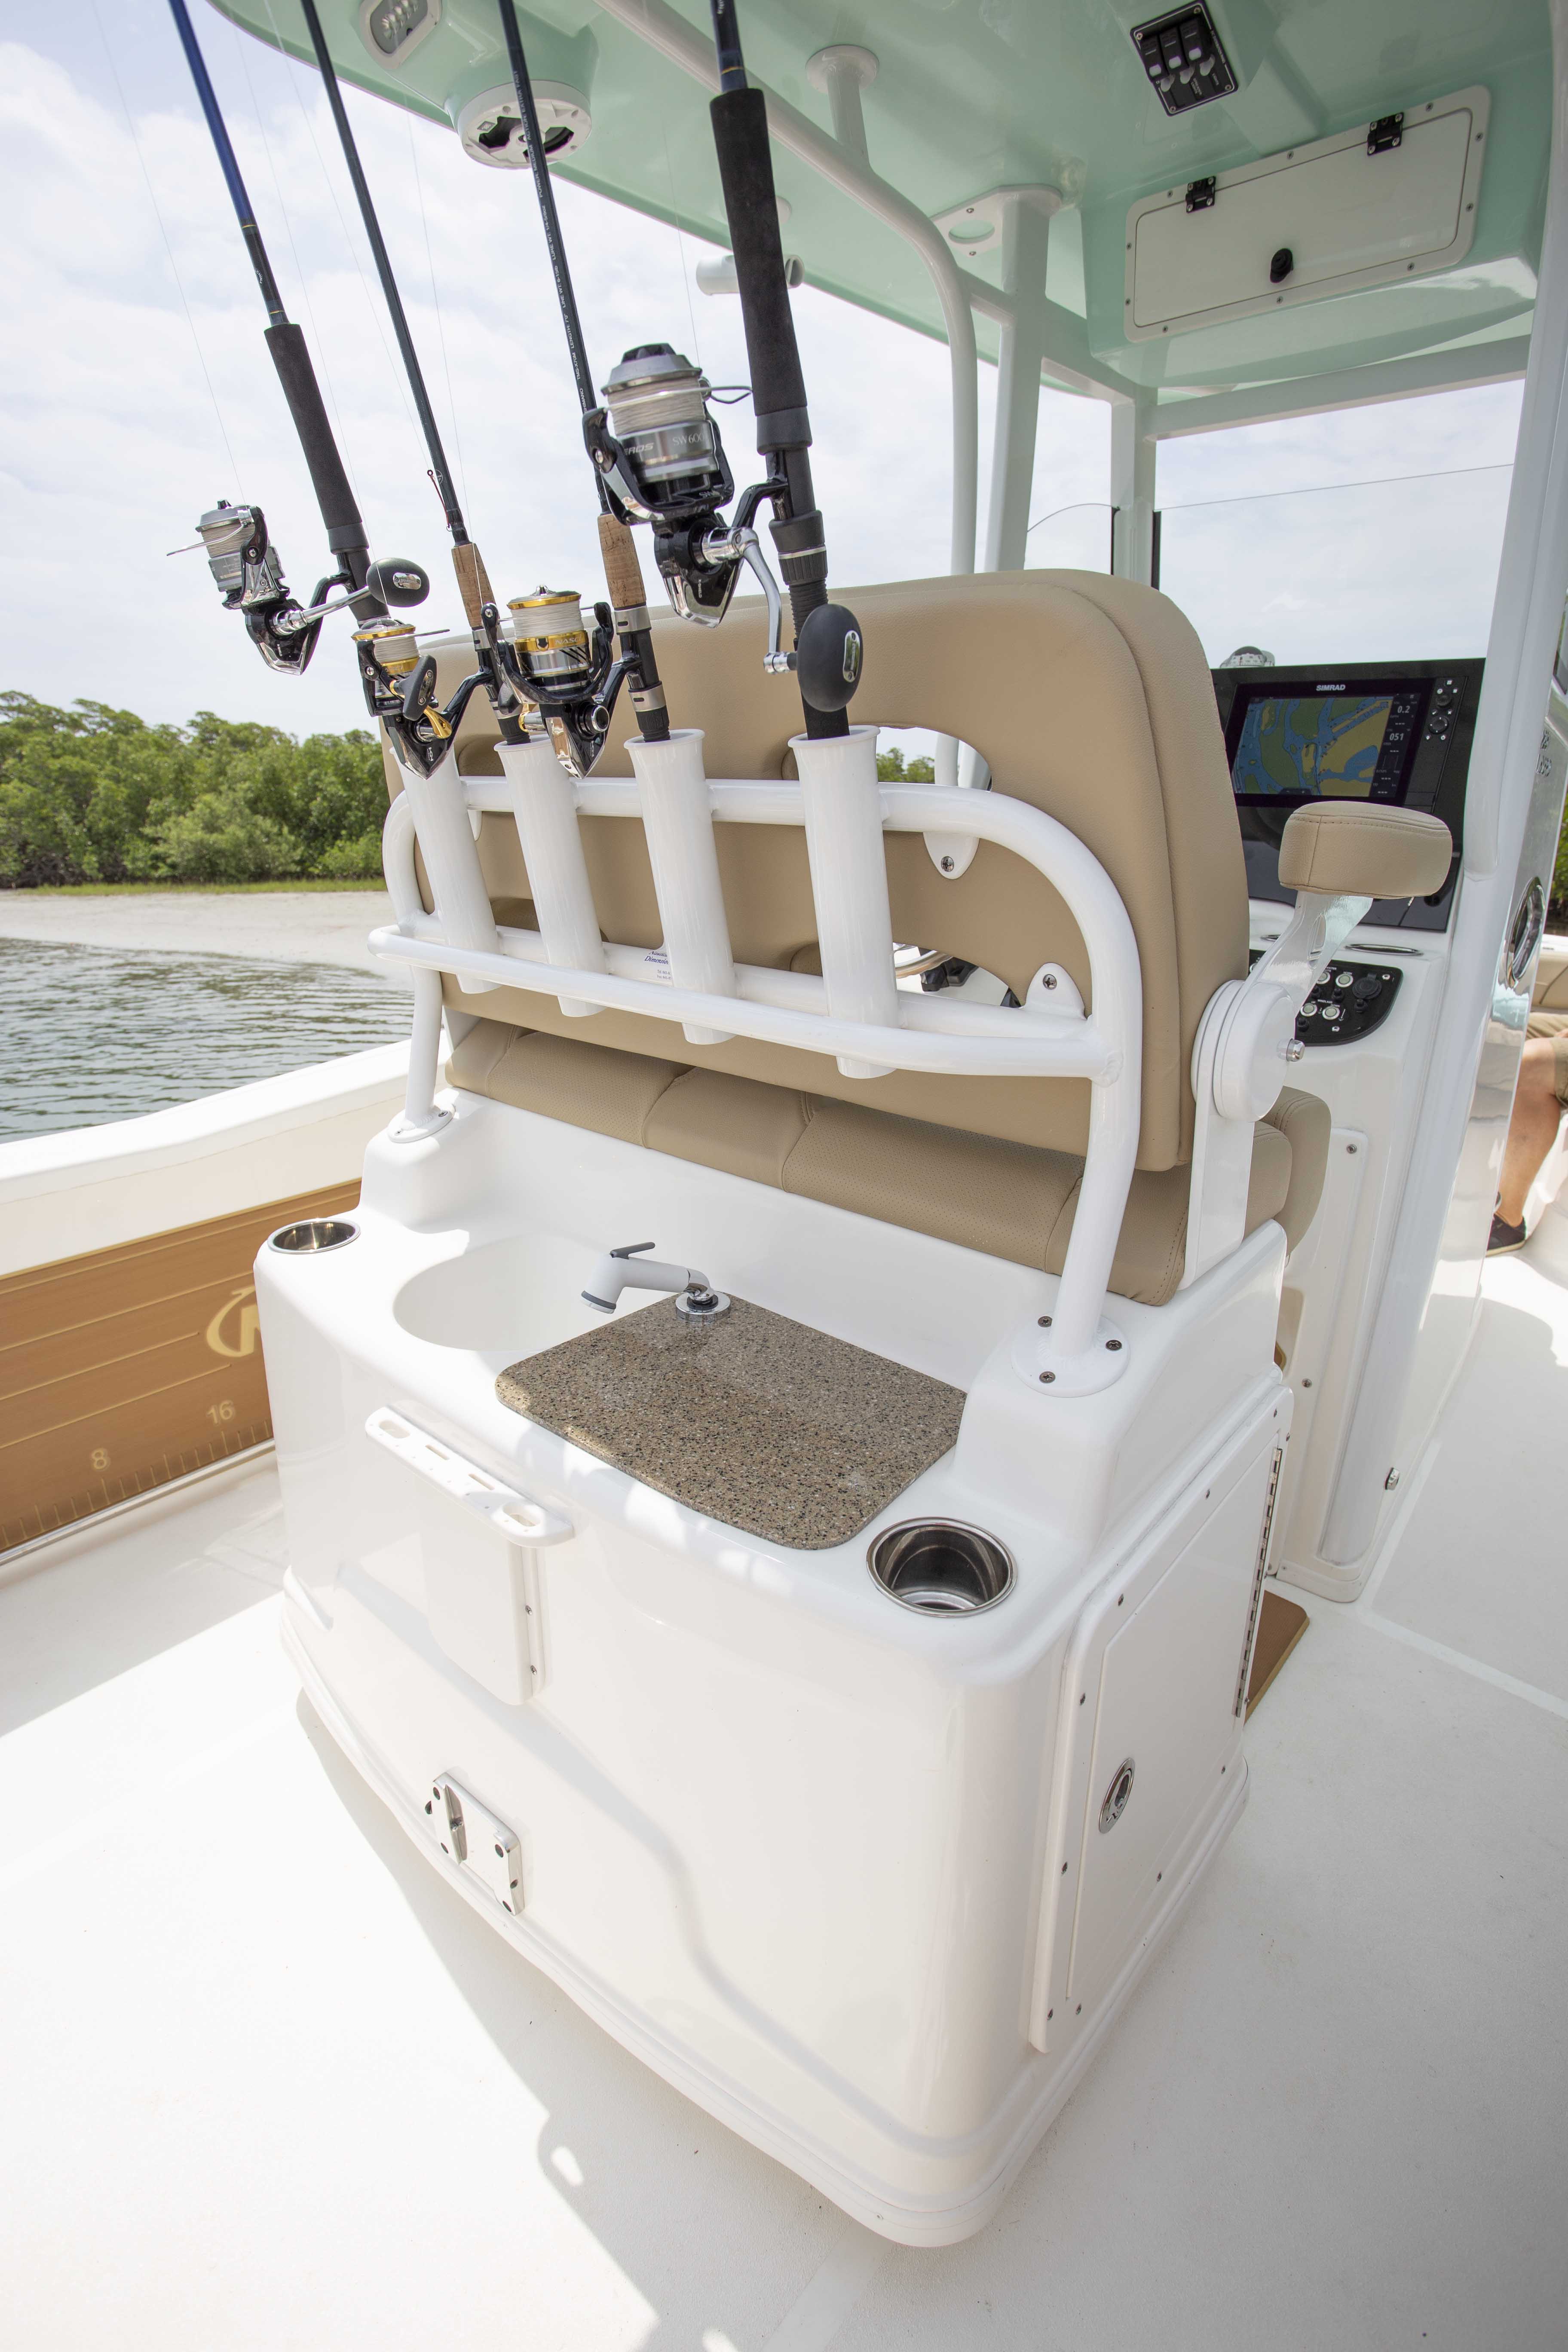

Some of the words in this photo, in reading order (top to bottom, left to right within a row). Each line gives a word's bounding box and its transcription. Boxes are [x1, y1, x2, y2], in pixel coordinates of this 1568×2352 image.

[529, 145, 537, 171] MEDIUM
[572, 352, 581, 380] TMS-X70M
[1397, 705, 1410, 714] 0.2
[207, 1400, 235, 1424] 16
[91, 1447, 110, 1471] 8
